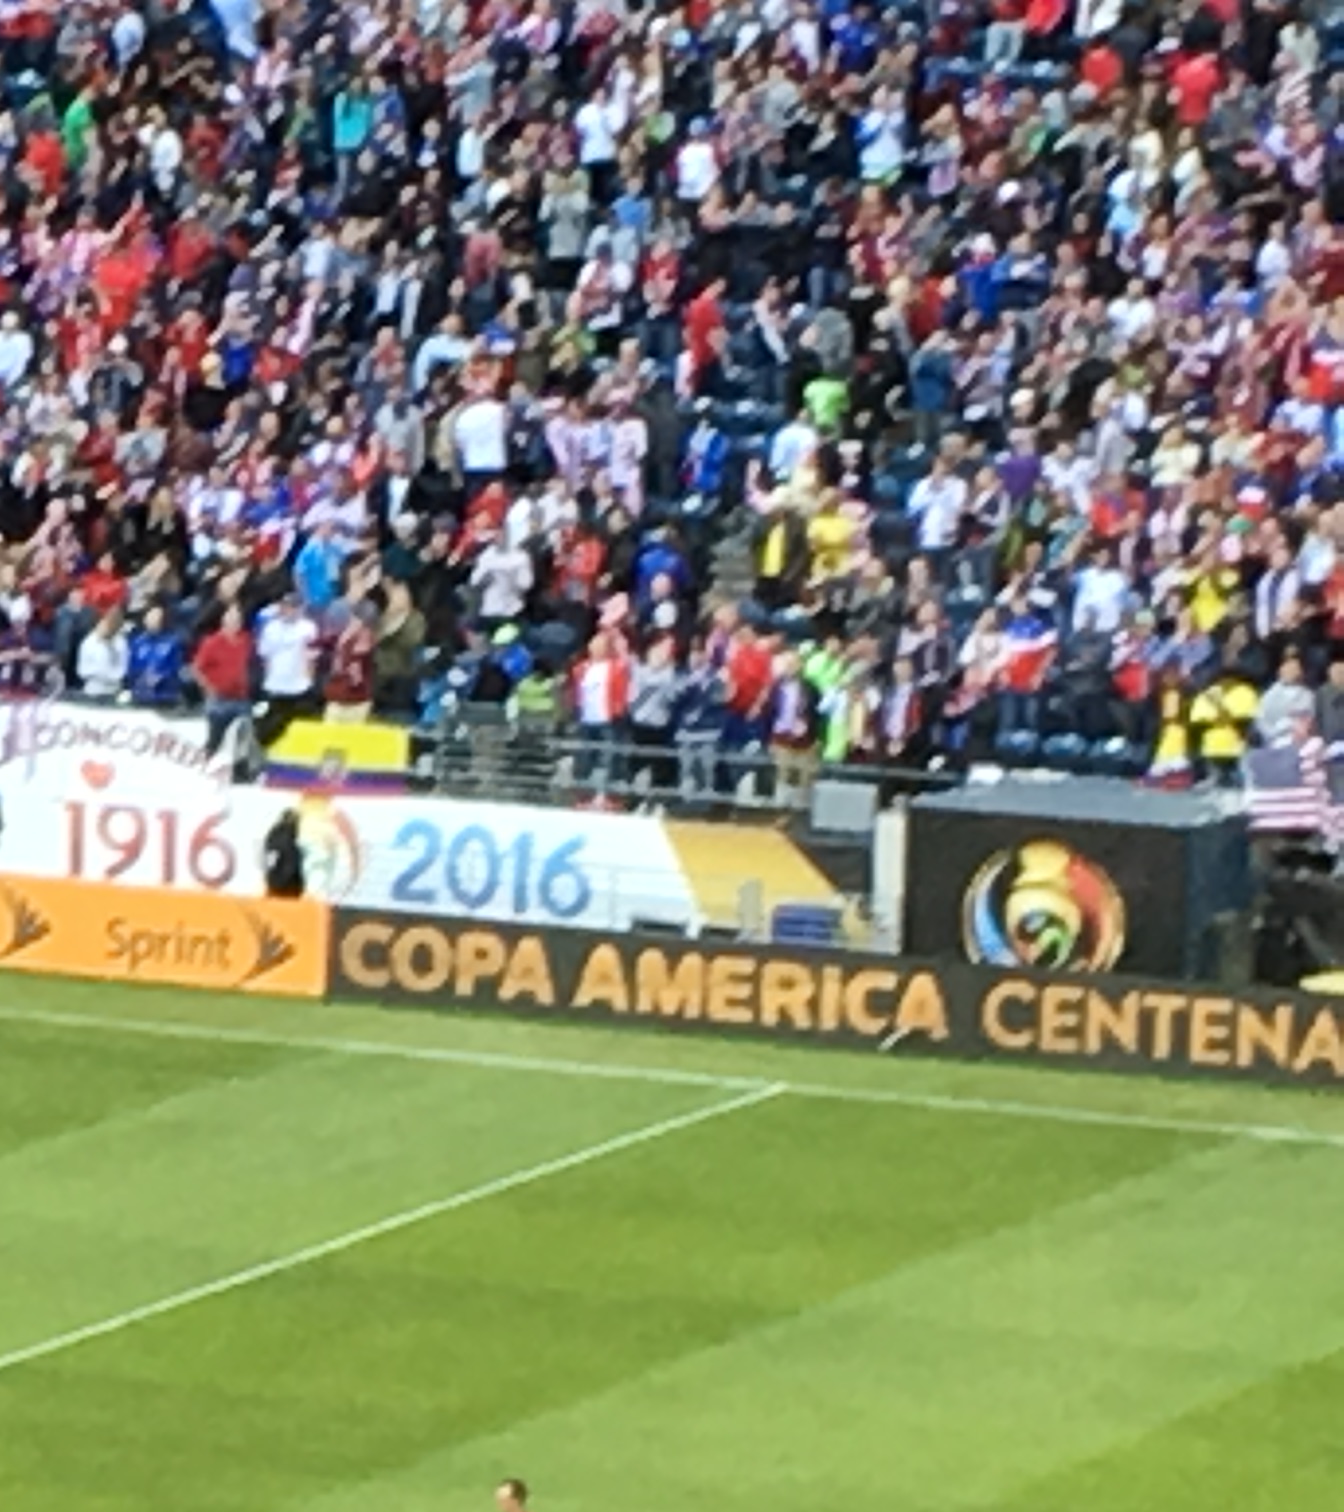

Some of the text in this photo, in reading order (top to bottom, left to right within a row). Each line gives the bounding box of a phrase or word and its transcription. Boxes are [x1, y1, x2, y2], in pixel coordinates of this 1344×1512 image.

[65, 800, 238, 890] 1916
[391, 817, 593, 919] 2016
[103, 917, 233, 973] Sprint
[340, 920, 556, 1007] COPA
[571, 942, 950, 1041] AMERICA
